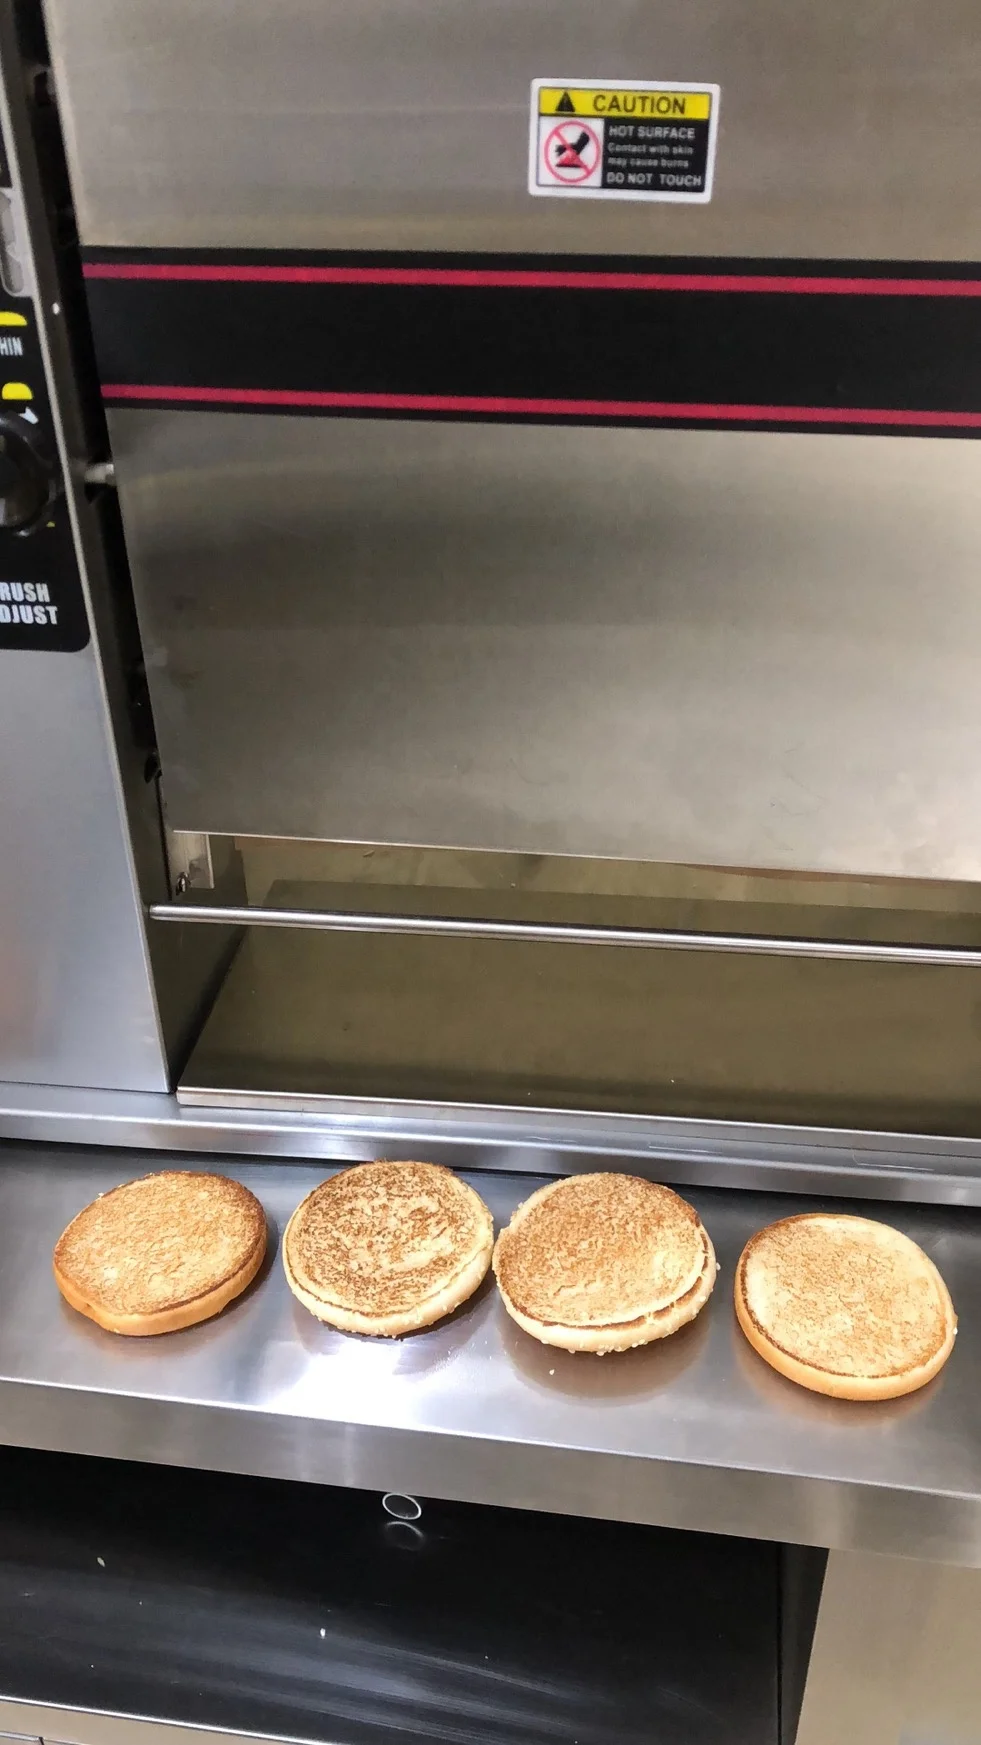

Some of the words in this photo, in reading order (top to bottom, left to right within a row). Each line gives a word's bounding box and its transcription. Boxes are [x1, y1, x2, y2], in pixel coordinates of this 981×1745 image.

[593, 94, 686, 115] CAUTION
[608, 125, 635, 137] HOT
[637, 125, 696, 140] SURFACE
[607, 142, 647, 154] Contact
[648, 143, 670, 155] with
[672, 145, 694, 156] skin
[607, 157, 627, 168] may
[629, 158, 659, 168] cause
[660, 157, 689, 169] burns
[606, 171, 625, 185] DO
[627, 172, 653, 185] NOT
[659, 173, 702, 188] TOUCH
